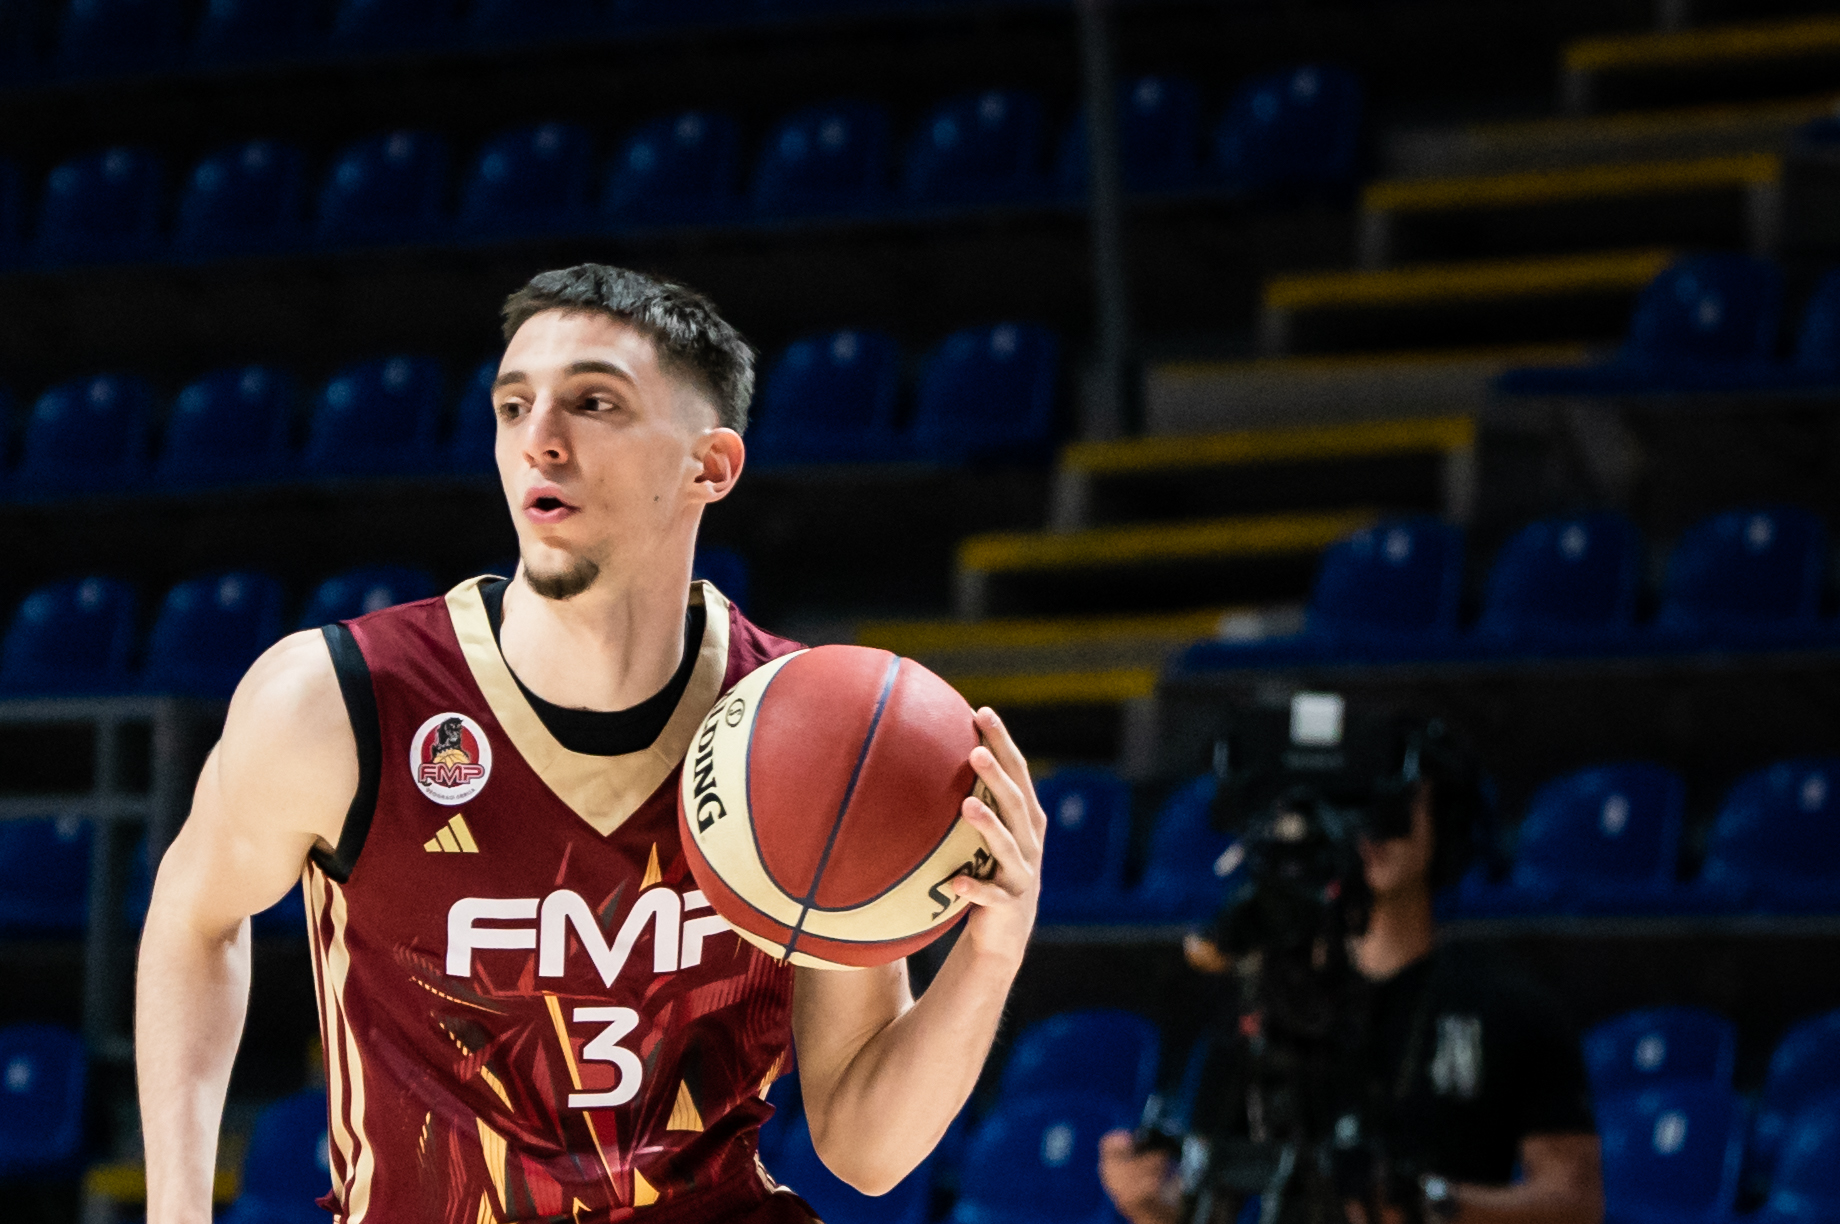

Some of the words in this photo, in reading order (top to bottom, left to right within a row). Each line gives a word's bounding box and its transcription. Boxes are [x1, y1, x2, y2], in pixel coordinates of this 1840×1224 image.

[418, 763, 485, 787] FMP
[693, 685, 737, 834] LDING
[567, 1006, 643, 1108] 3
